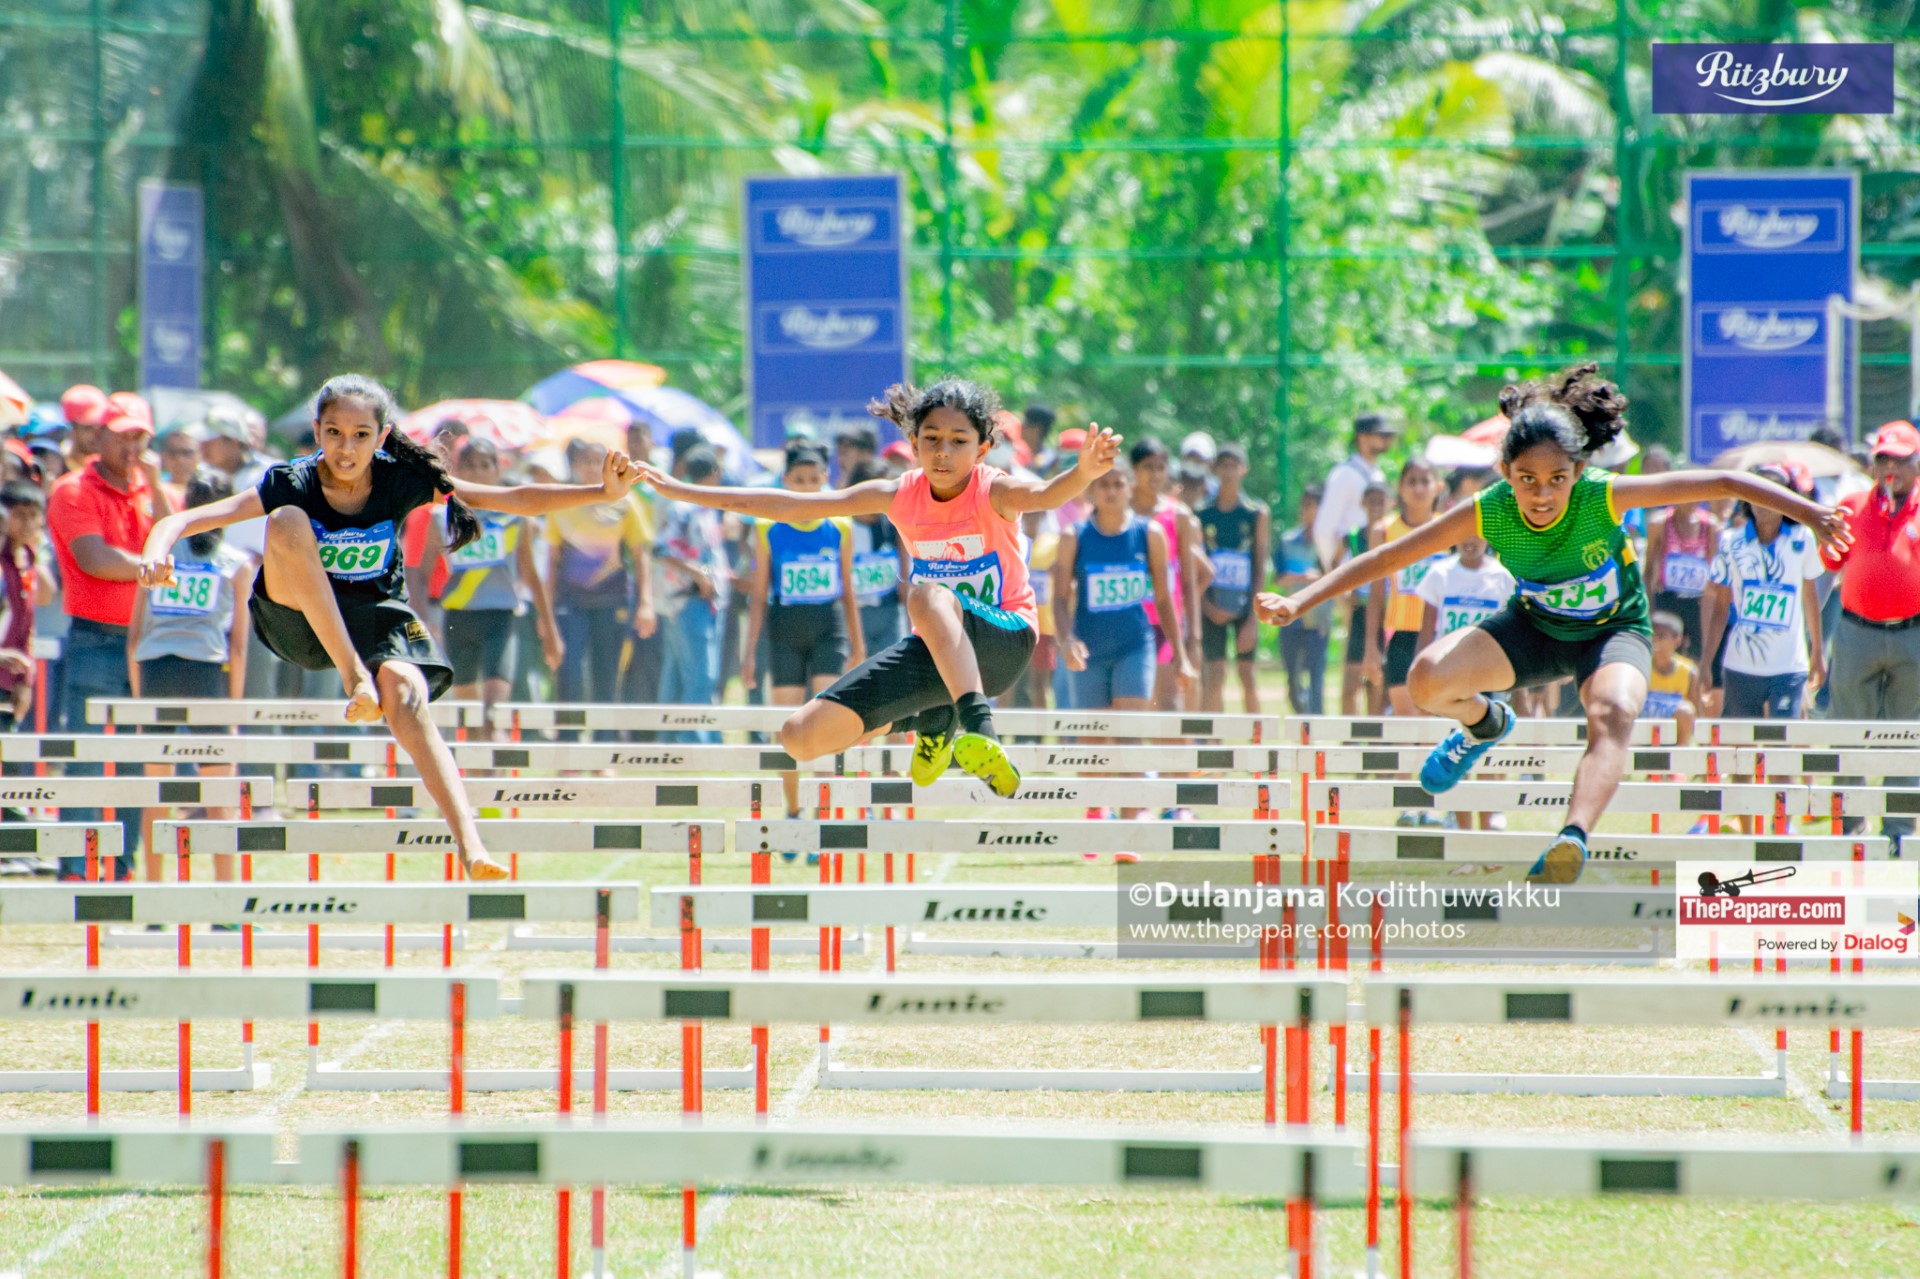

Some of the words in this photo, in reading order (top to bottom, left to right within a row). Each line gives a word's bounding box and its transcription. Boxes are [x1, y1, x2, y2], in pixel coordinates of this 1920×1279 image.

[1096, 577, 1142, 604] 3530
[1744, 591, 1787, 621] 3471
[661, 714, 717, 725] Lanic
[1053, 720, 1110, 731] Lanic
[161, 744, 225, 756] Lanic
[610, 752, 684, 765] Lanic
[1047, 754, 1110, 766] Lanic
[1482, 756, 1547, 768] Lanic
[0, 787, 56, 801] anic
[493, 788, 578, 802] Lanic
[1517, 792, 1573, 807] Lani
[396, 830, 456, 846] Lan
[976, 830, 1059, 846] Lanic
[242, 896, 359, 914] Lanic
[922, 899, 1048, 922] Lanic
